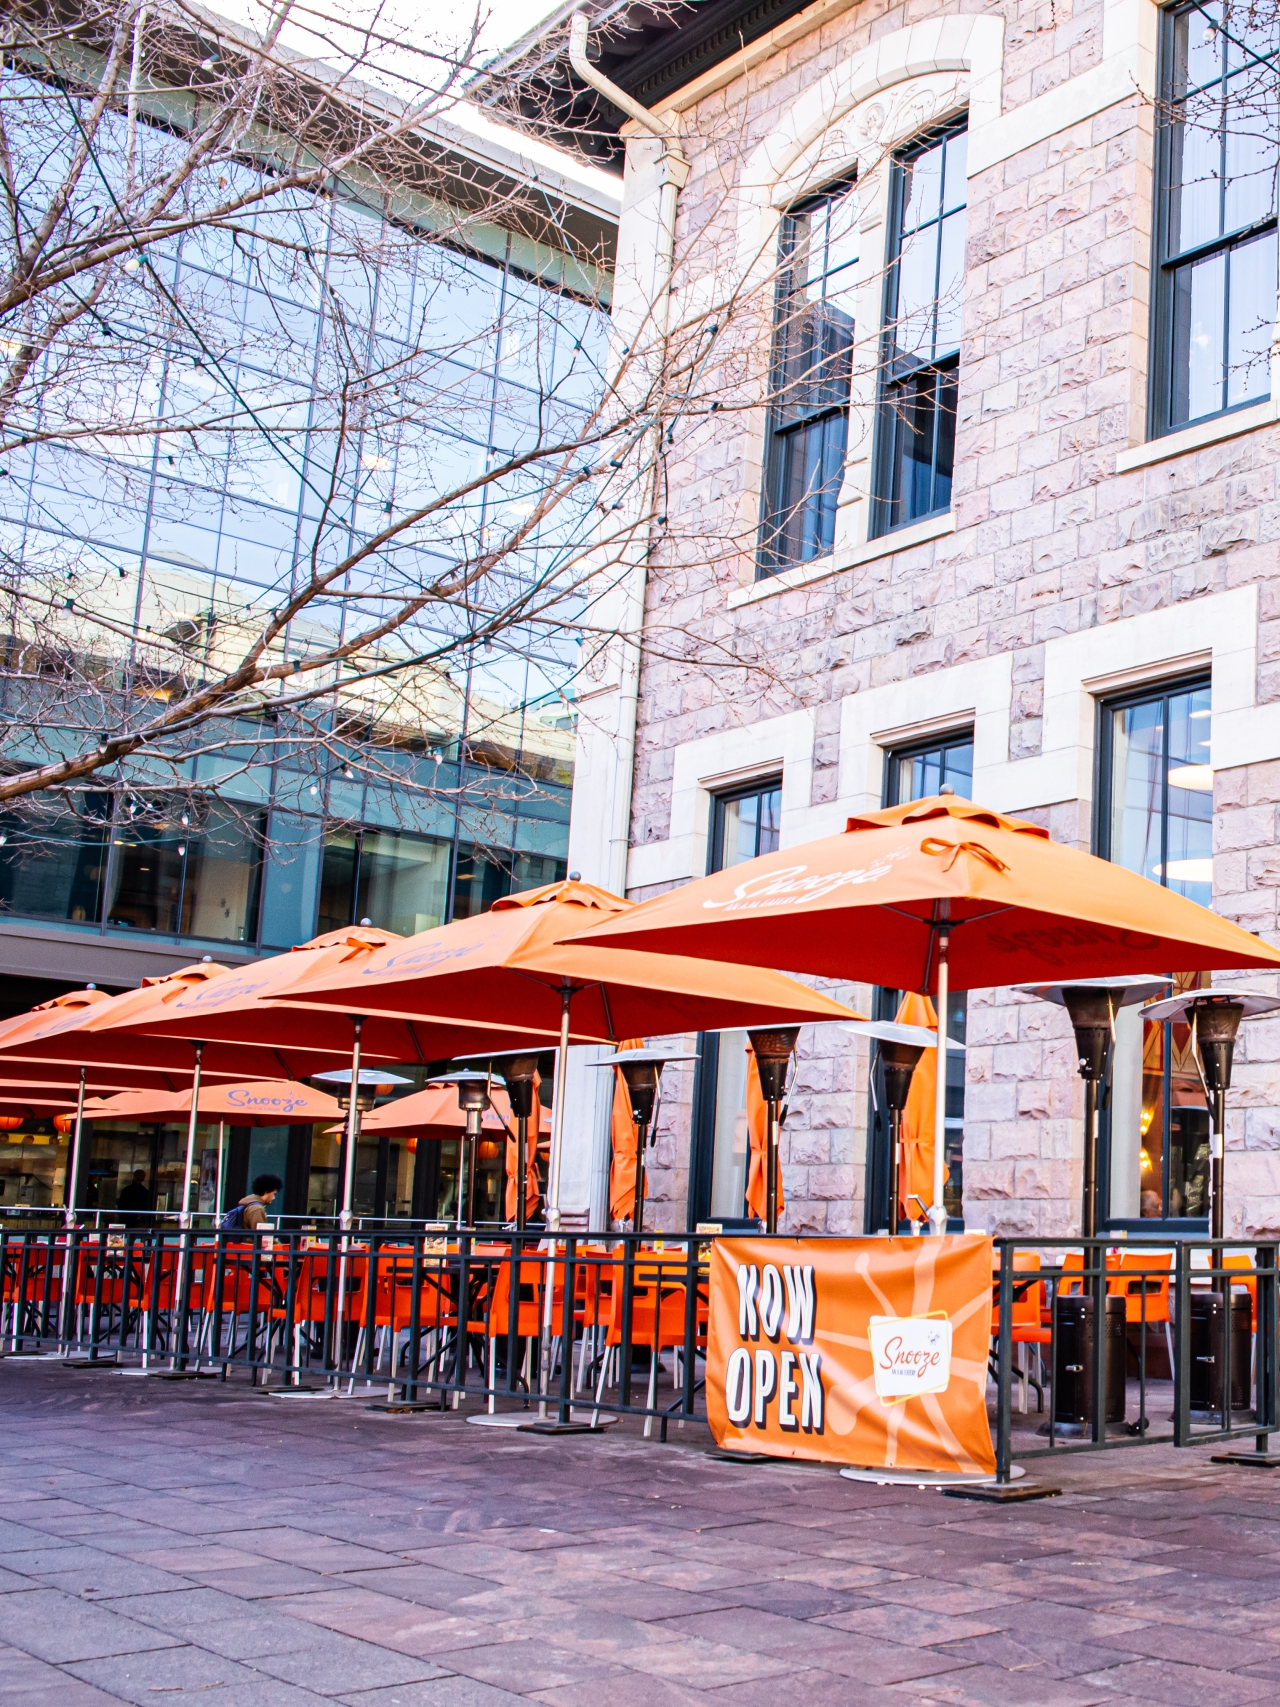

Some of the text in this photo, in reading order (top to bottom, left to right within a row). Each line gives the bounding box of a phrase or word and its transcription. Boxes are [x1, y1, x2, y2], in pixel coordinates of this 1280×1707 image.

[227, 1089, 308, 1112] Snooze
[736, 1264, 816, 1343] NOW
[880, 1335, 941, 1378] Snooze
[726, 1347, 824, 1433] OPEN
